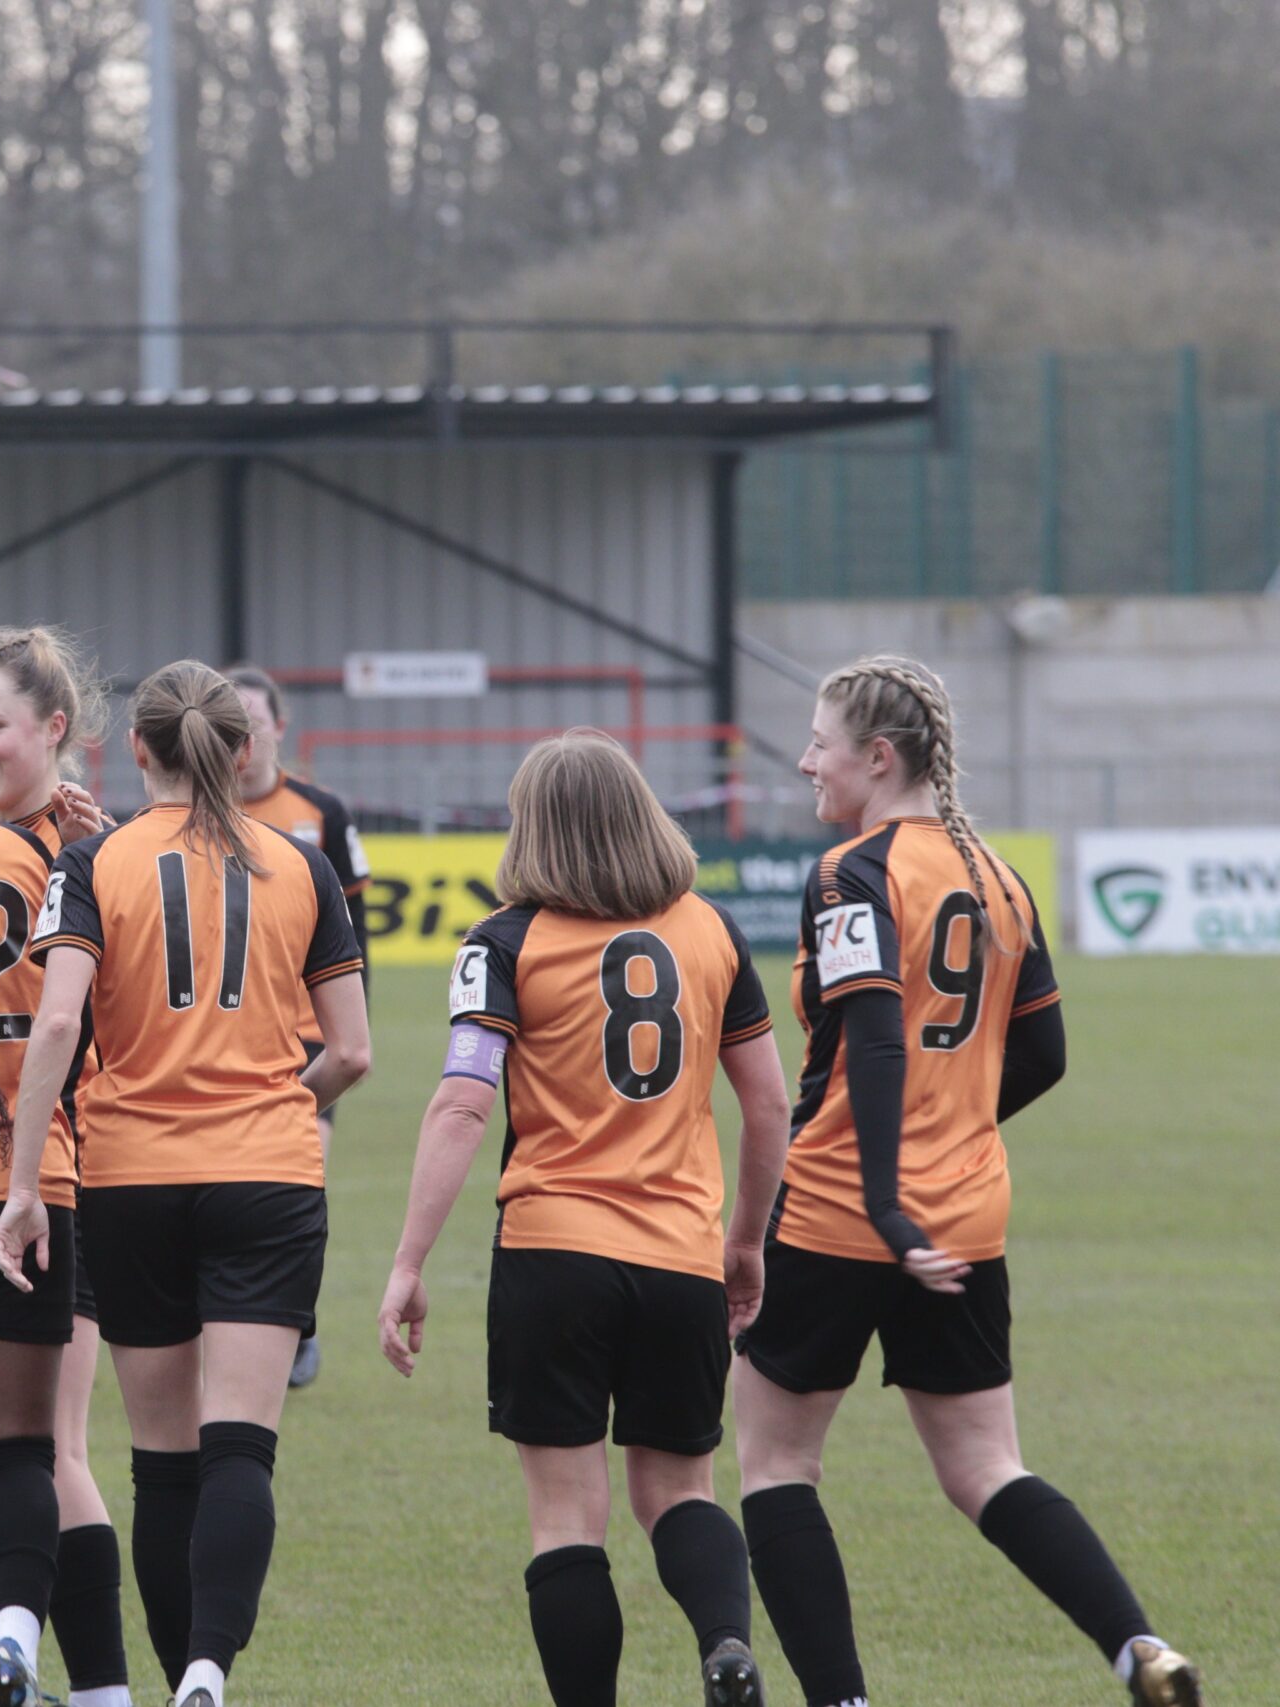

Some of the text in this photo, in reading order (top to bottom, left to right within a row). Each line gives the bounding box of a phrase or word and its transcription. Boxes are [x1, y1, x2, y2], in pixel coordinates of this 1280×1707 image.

[157, 850, 252, 1012] 11
[920, 889, 988, 1052] 9
[600, 929, 684, 1102] 8
